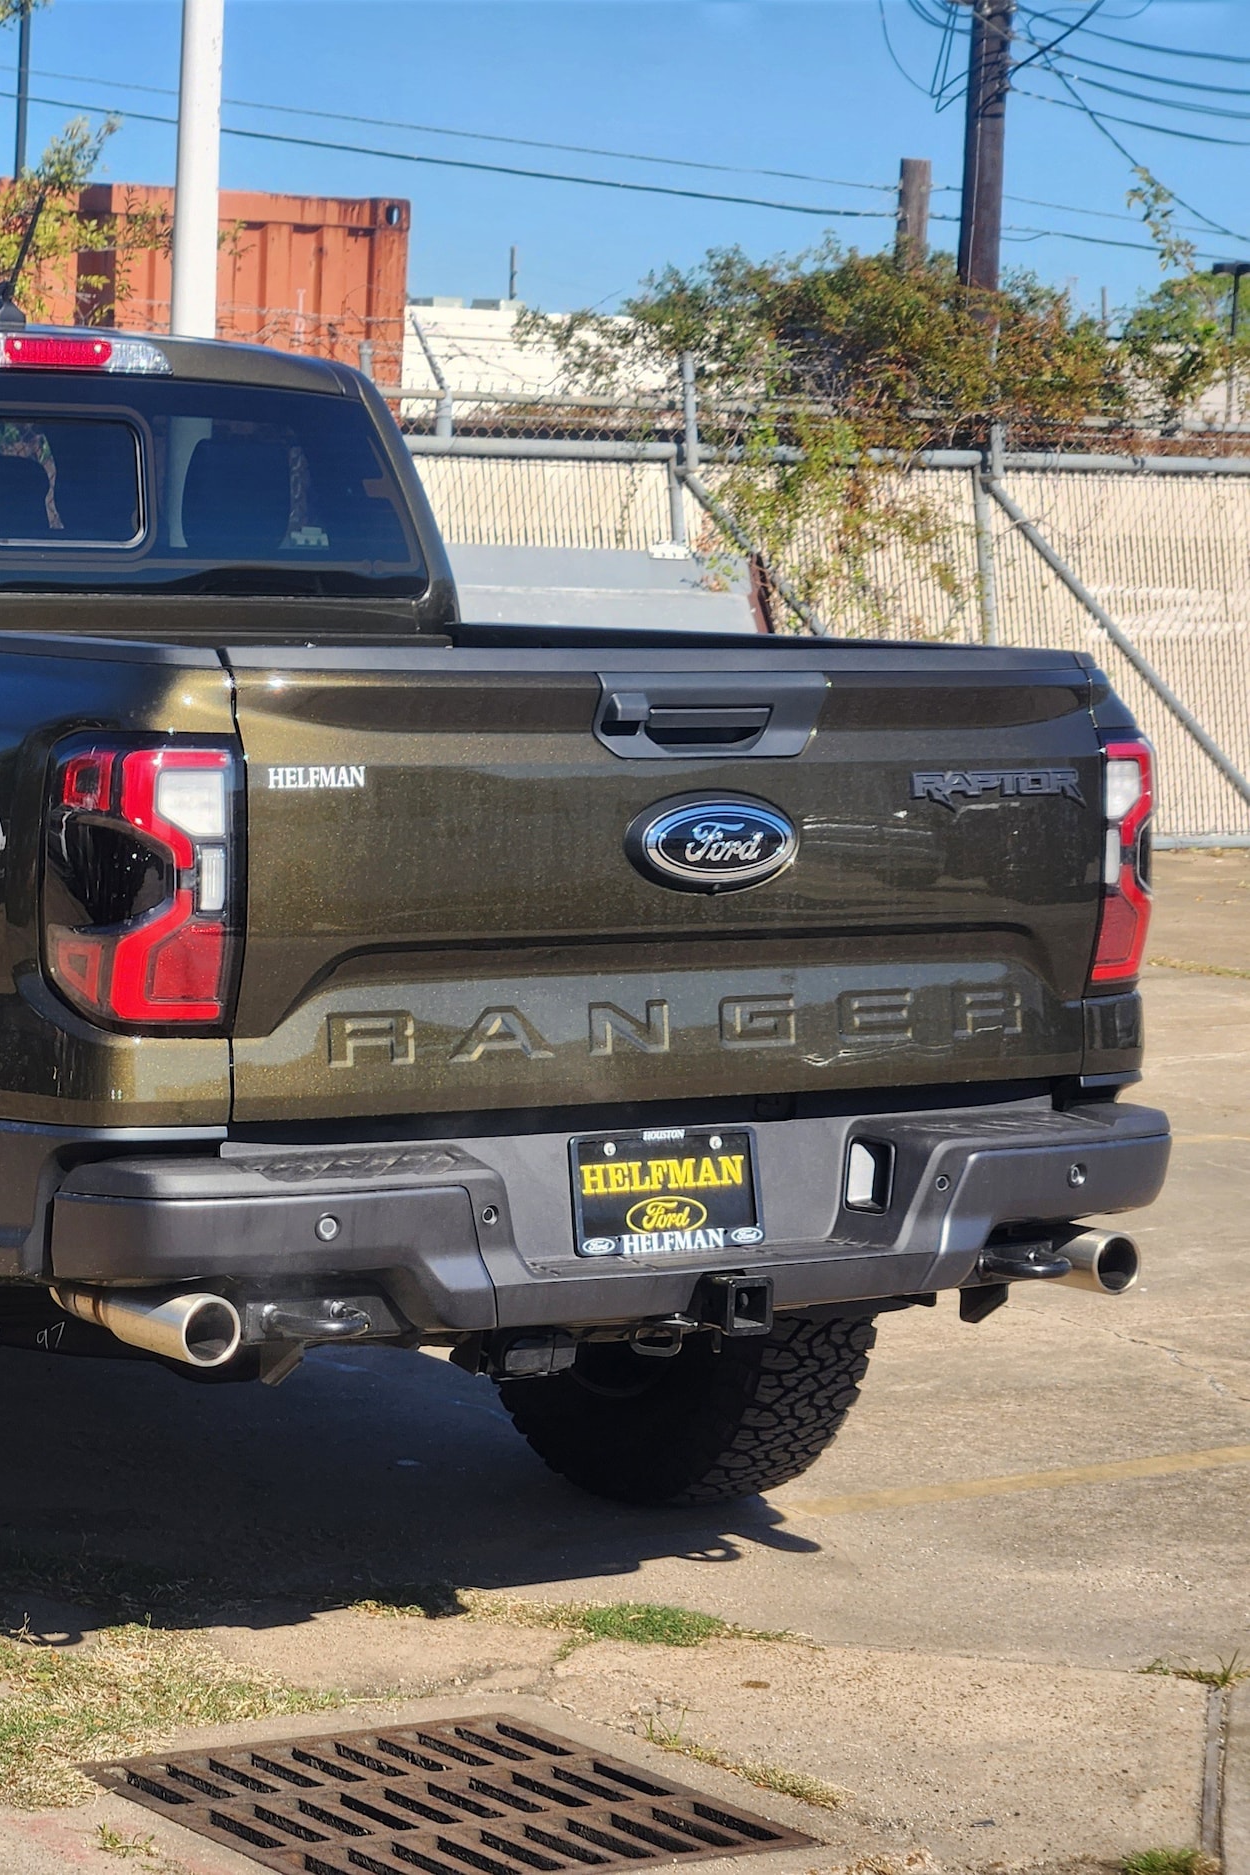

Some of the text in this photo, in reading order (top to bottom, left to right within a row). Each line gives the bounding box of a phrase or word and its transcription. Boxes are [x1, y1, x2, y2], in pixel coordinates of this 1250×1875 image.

[268, 765, 366, 789] HELFMAN
[912, 769, 1086, 813] RAPTOR
[684, 821, 764, 862] Ford
[327, 988, 1021, 1068] RANGER
[643, 1129, 685, 1141] HOUSTON
[580, 1155, 744, 1195] HELFMAN
[642, 1201, 690, 1231] Ford
[622, 1228, 726, 1255] HELFMAN
[36, 1321, 66, 1350] 97
